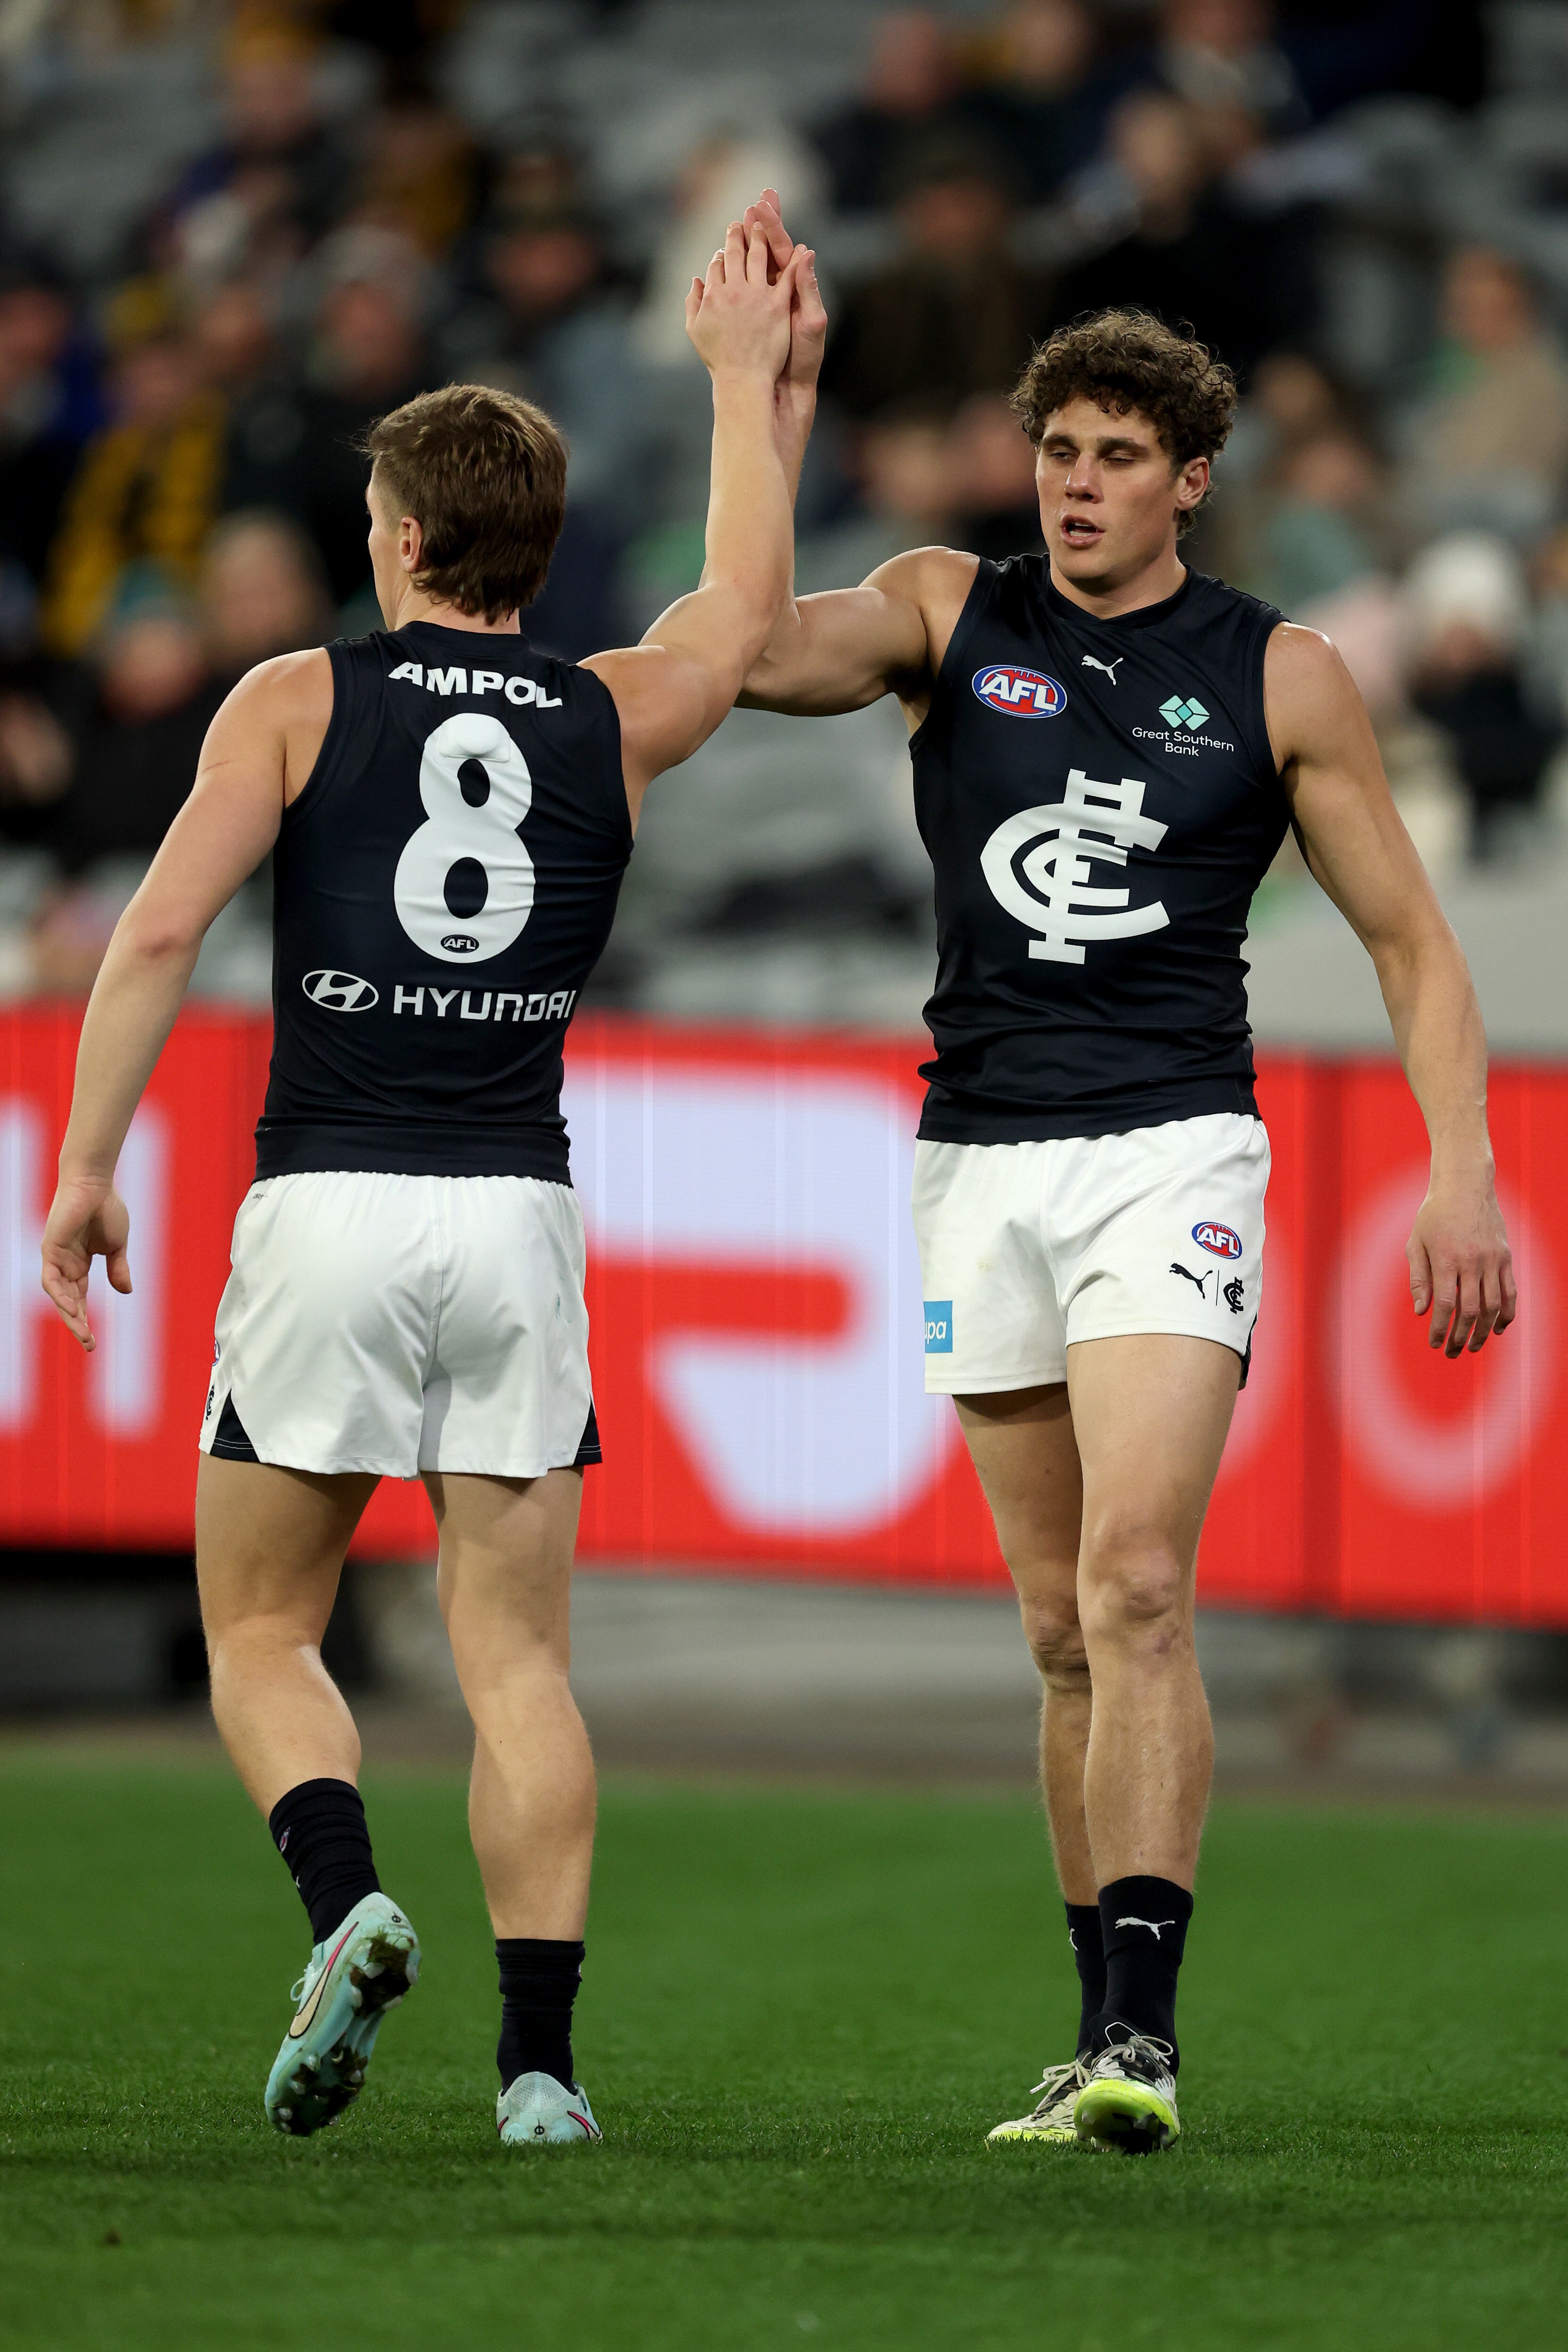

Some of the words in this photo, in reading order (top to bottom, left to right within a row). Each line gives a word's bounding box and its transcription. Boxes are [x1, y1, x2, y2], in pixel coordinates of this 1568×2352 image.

[388, 661, 563, 708] AMPOL
[978, 673, 1057, 711] AFL
[1132, 727, 1170, 741] Great
[1173, 731, 1234, 752] Southern
[1165, 742, 1200, 757] Bank
[394, 713, 536, 963] 8
[444, 938, 476, 950] AFL
[393, 985, 576, 1022] HYUNDAI
[1196, 1226, 1239, 1257] AFL
